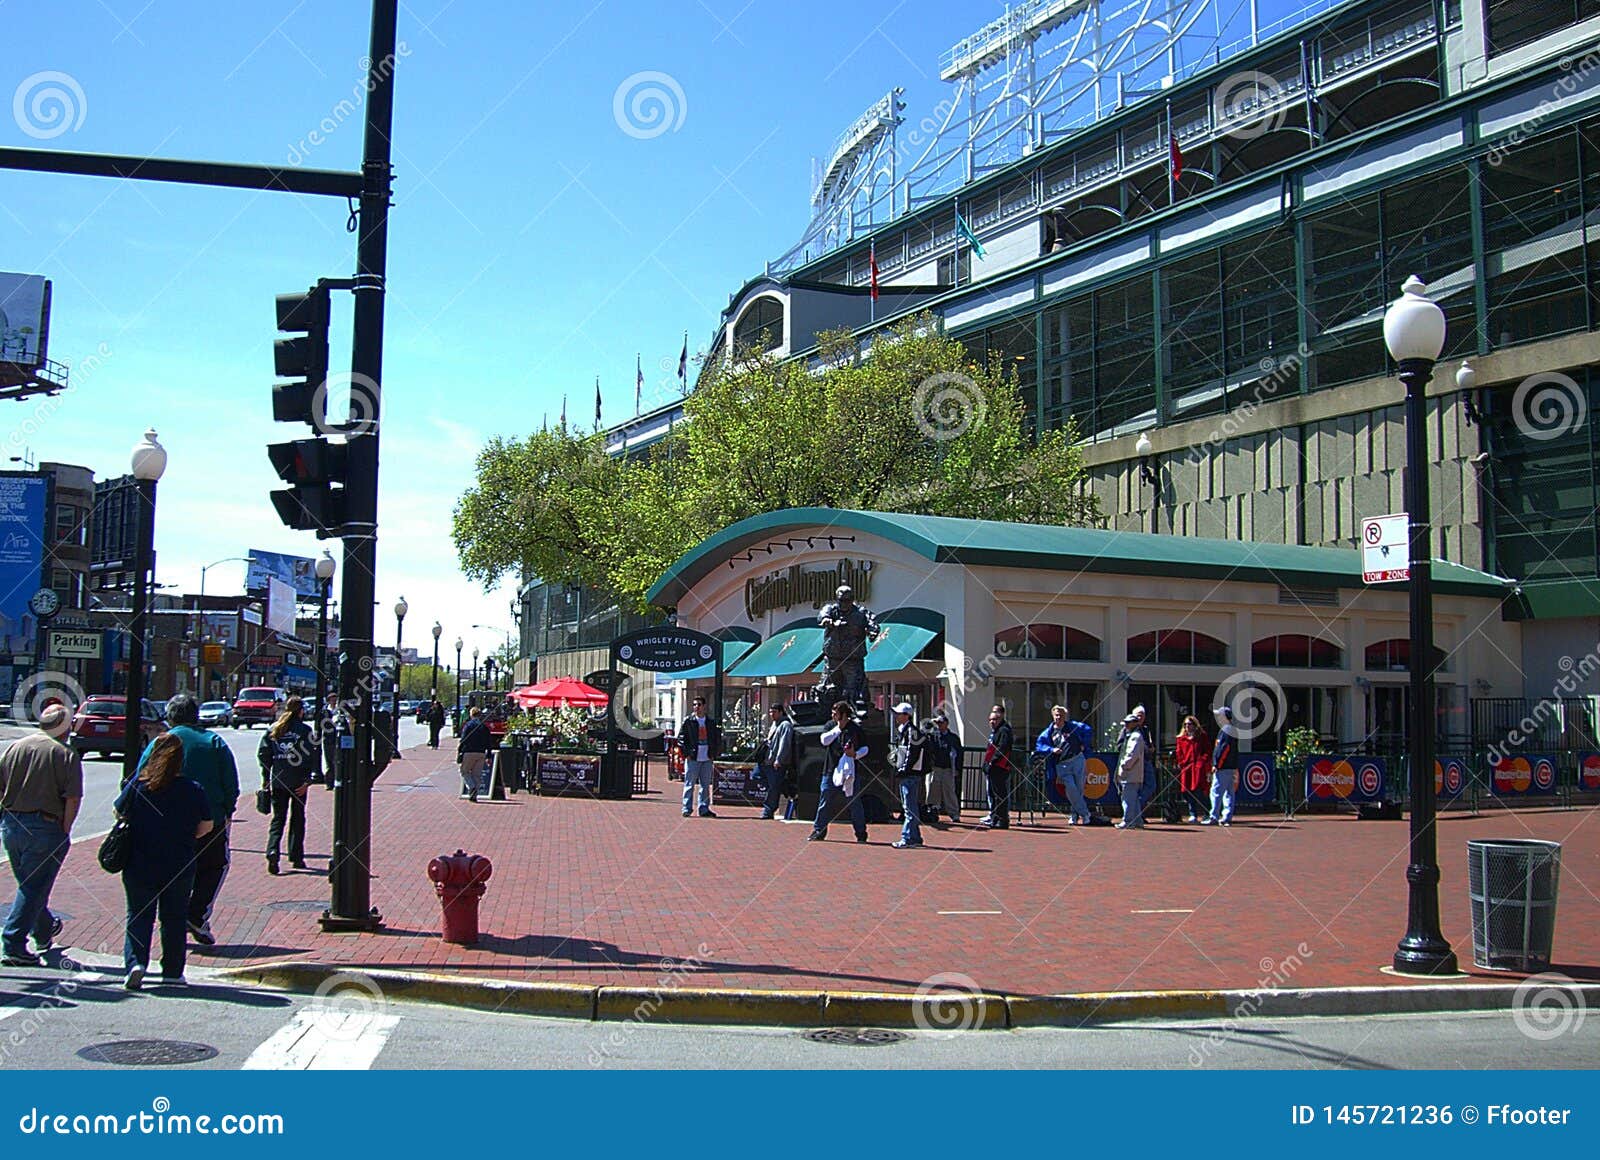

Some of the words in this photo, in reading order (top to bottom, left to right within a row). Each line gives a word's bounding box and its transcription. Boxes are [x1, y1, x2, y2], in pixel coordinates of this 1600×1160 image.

[1386, 569, 1408, 580] ZONE
[53, 634, 97, 650] Parking
[636, 637, 673, 647] WRIGLEY
[674, 637, 697, 646] FIELD
[634, 658, 671, 668] CHICAGO
[674, 658, 697, 667] CUBS
